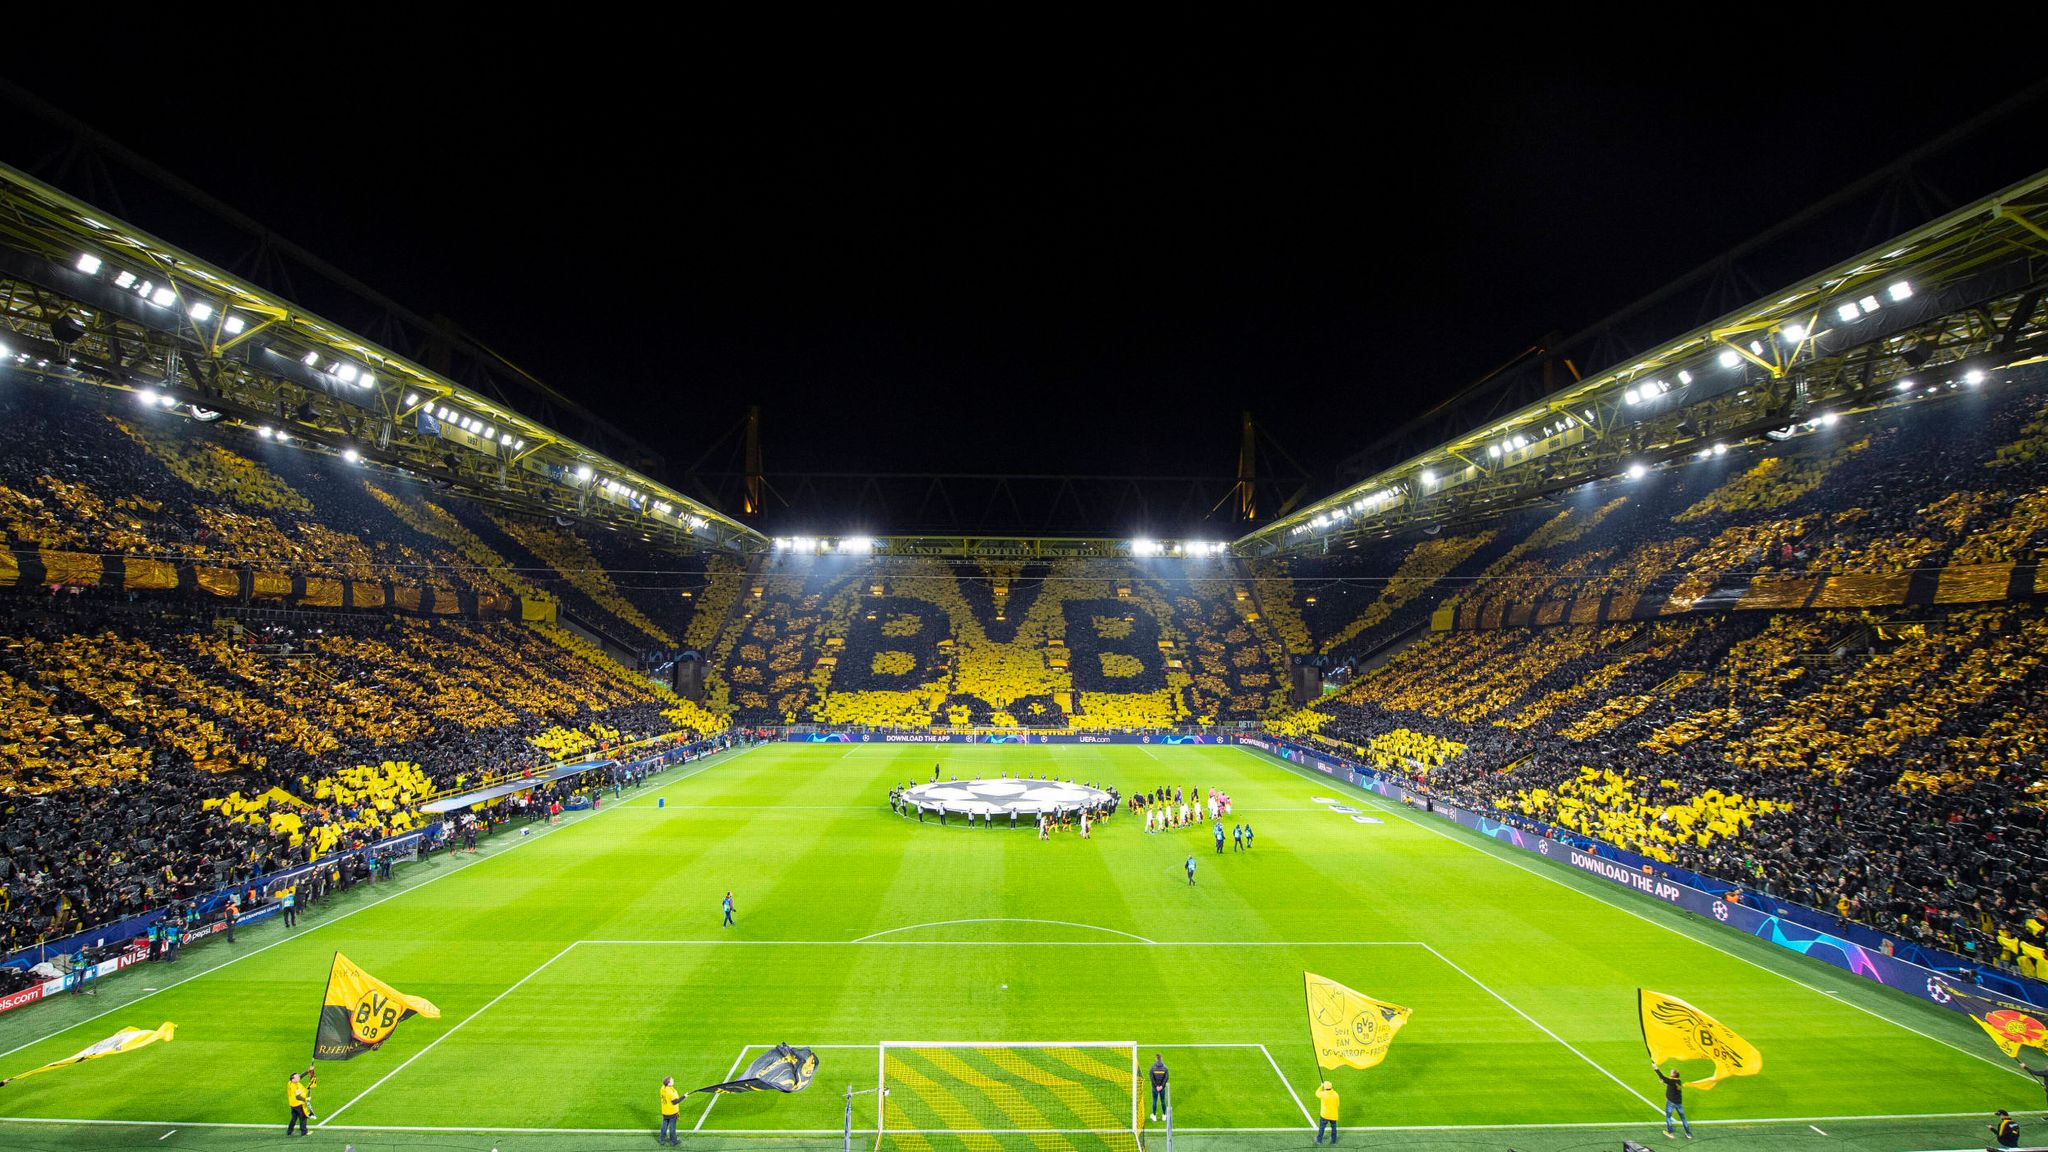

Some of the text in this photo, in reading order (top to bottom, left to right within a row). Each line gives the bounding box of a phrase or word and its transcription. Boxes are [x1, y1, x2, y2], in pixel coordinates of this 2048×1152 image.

[1570, 851, 1680, 902] DOWNLOAD THE APP
[191, 926, 211, 941] pepsi
[355, 993, 397, 1028] BVB
[362, 1026, 378, 1039] 09
[1357, 1017, 1374, 1033] BVB
